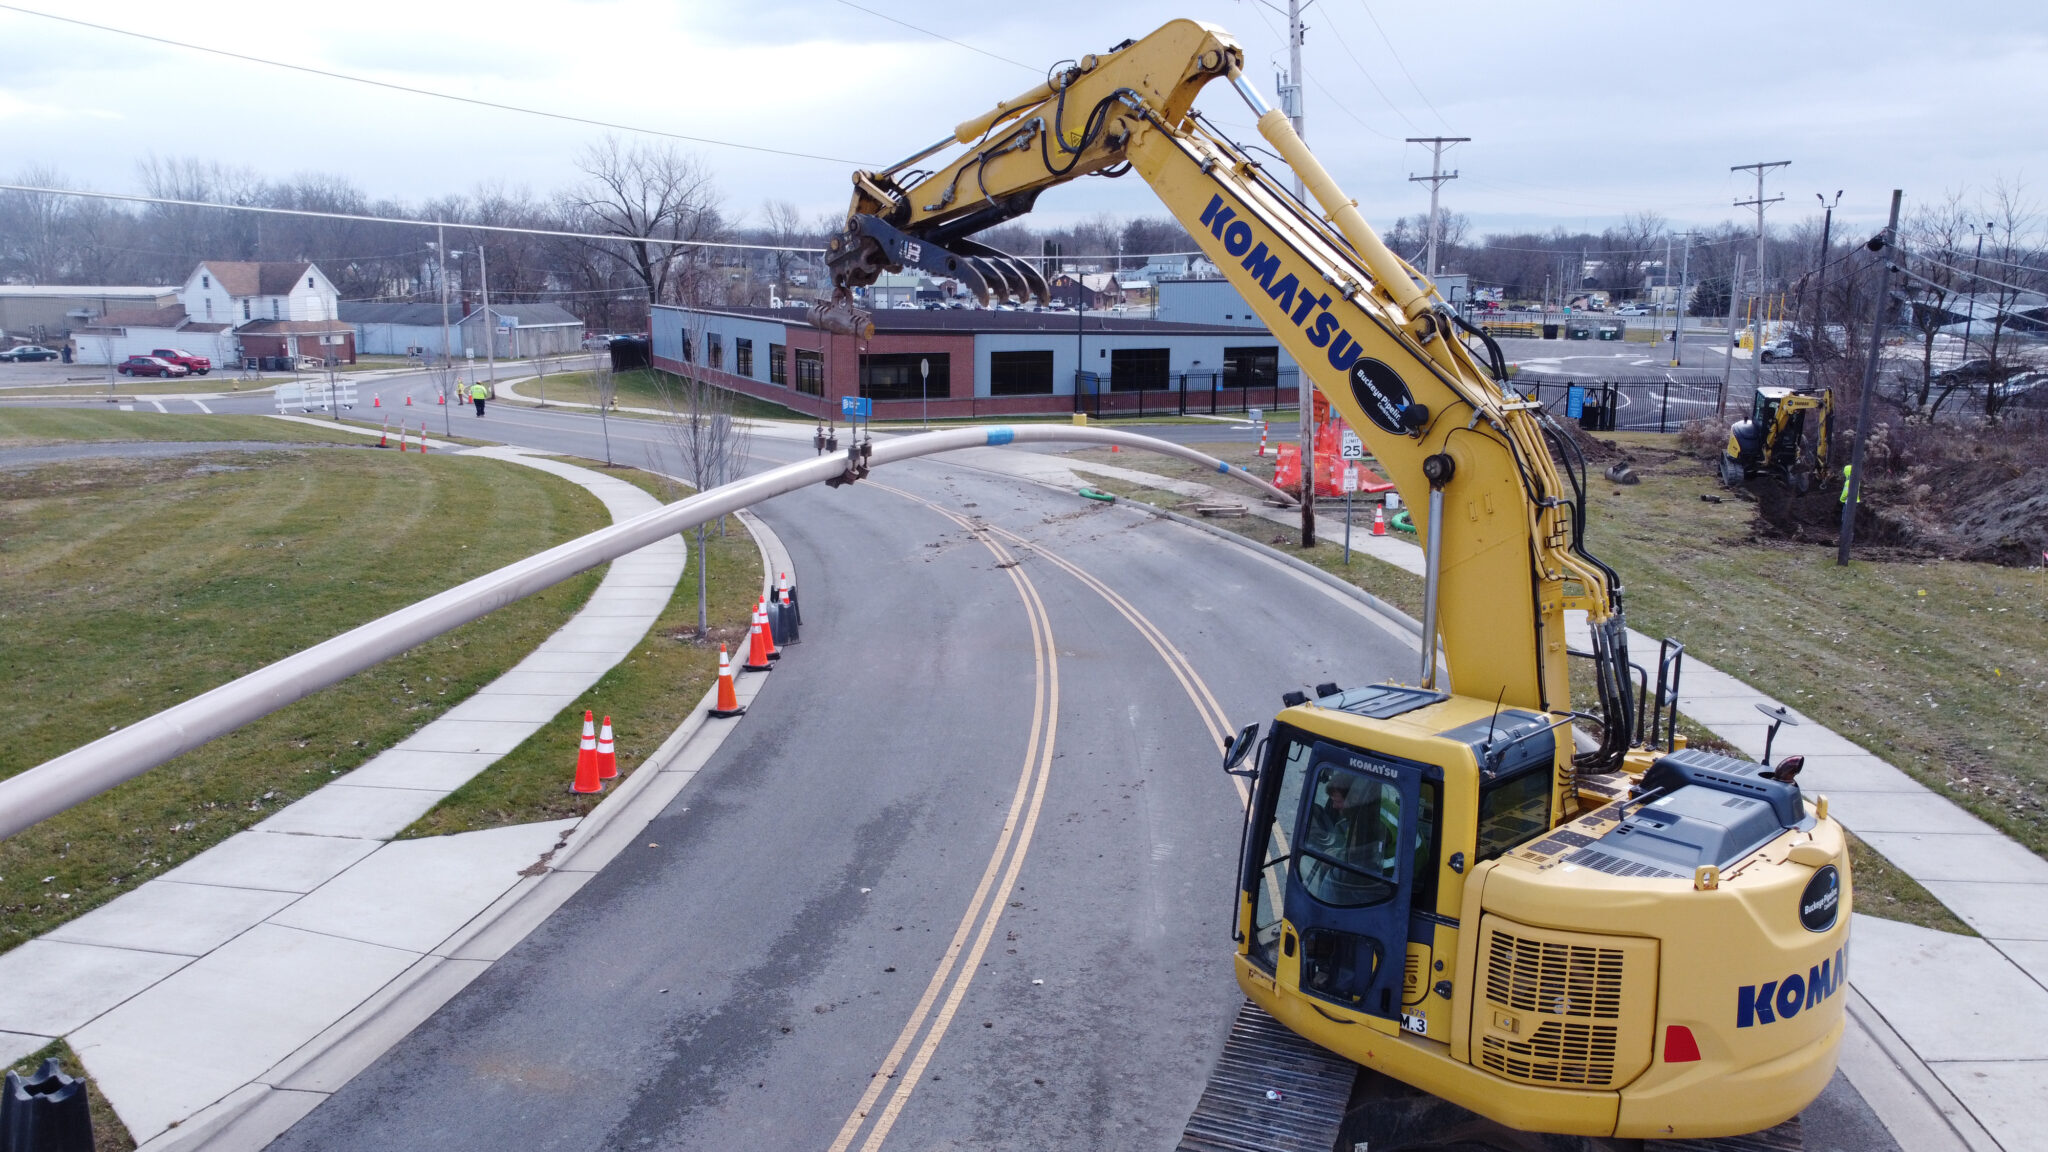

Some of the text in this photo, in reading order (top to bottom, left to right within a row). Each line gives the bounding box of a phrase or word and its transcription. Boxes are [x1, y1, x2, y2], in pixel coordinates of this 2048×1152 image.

[1199, 193, 1363, 371] KOMATSU
[1357, 369, 1402, 421] Buckeye Pipelin
[1343, 445, 1361, 457] 25
[1349, 757, 1398, 778] KOMATSU
